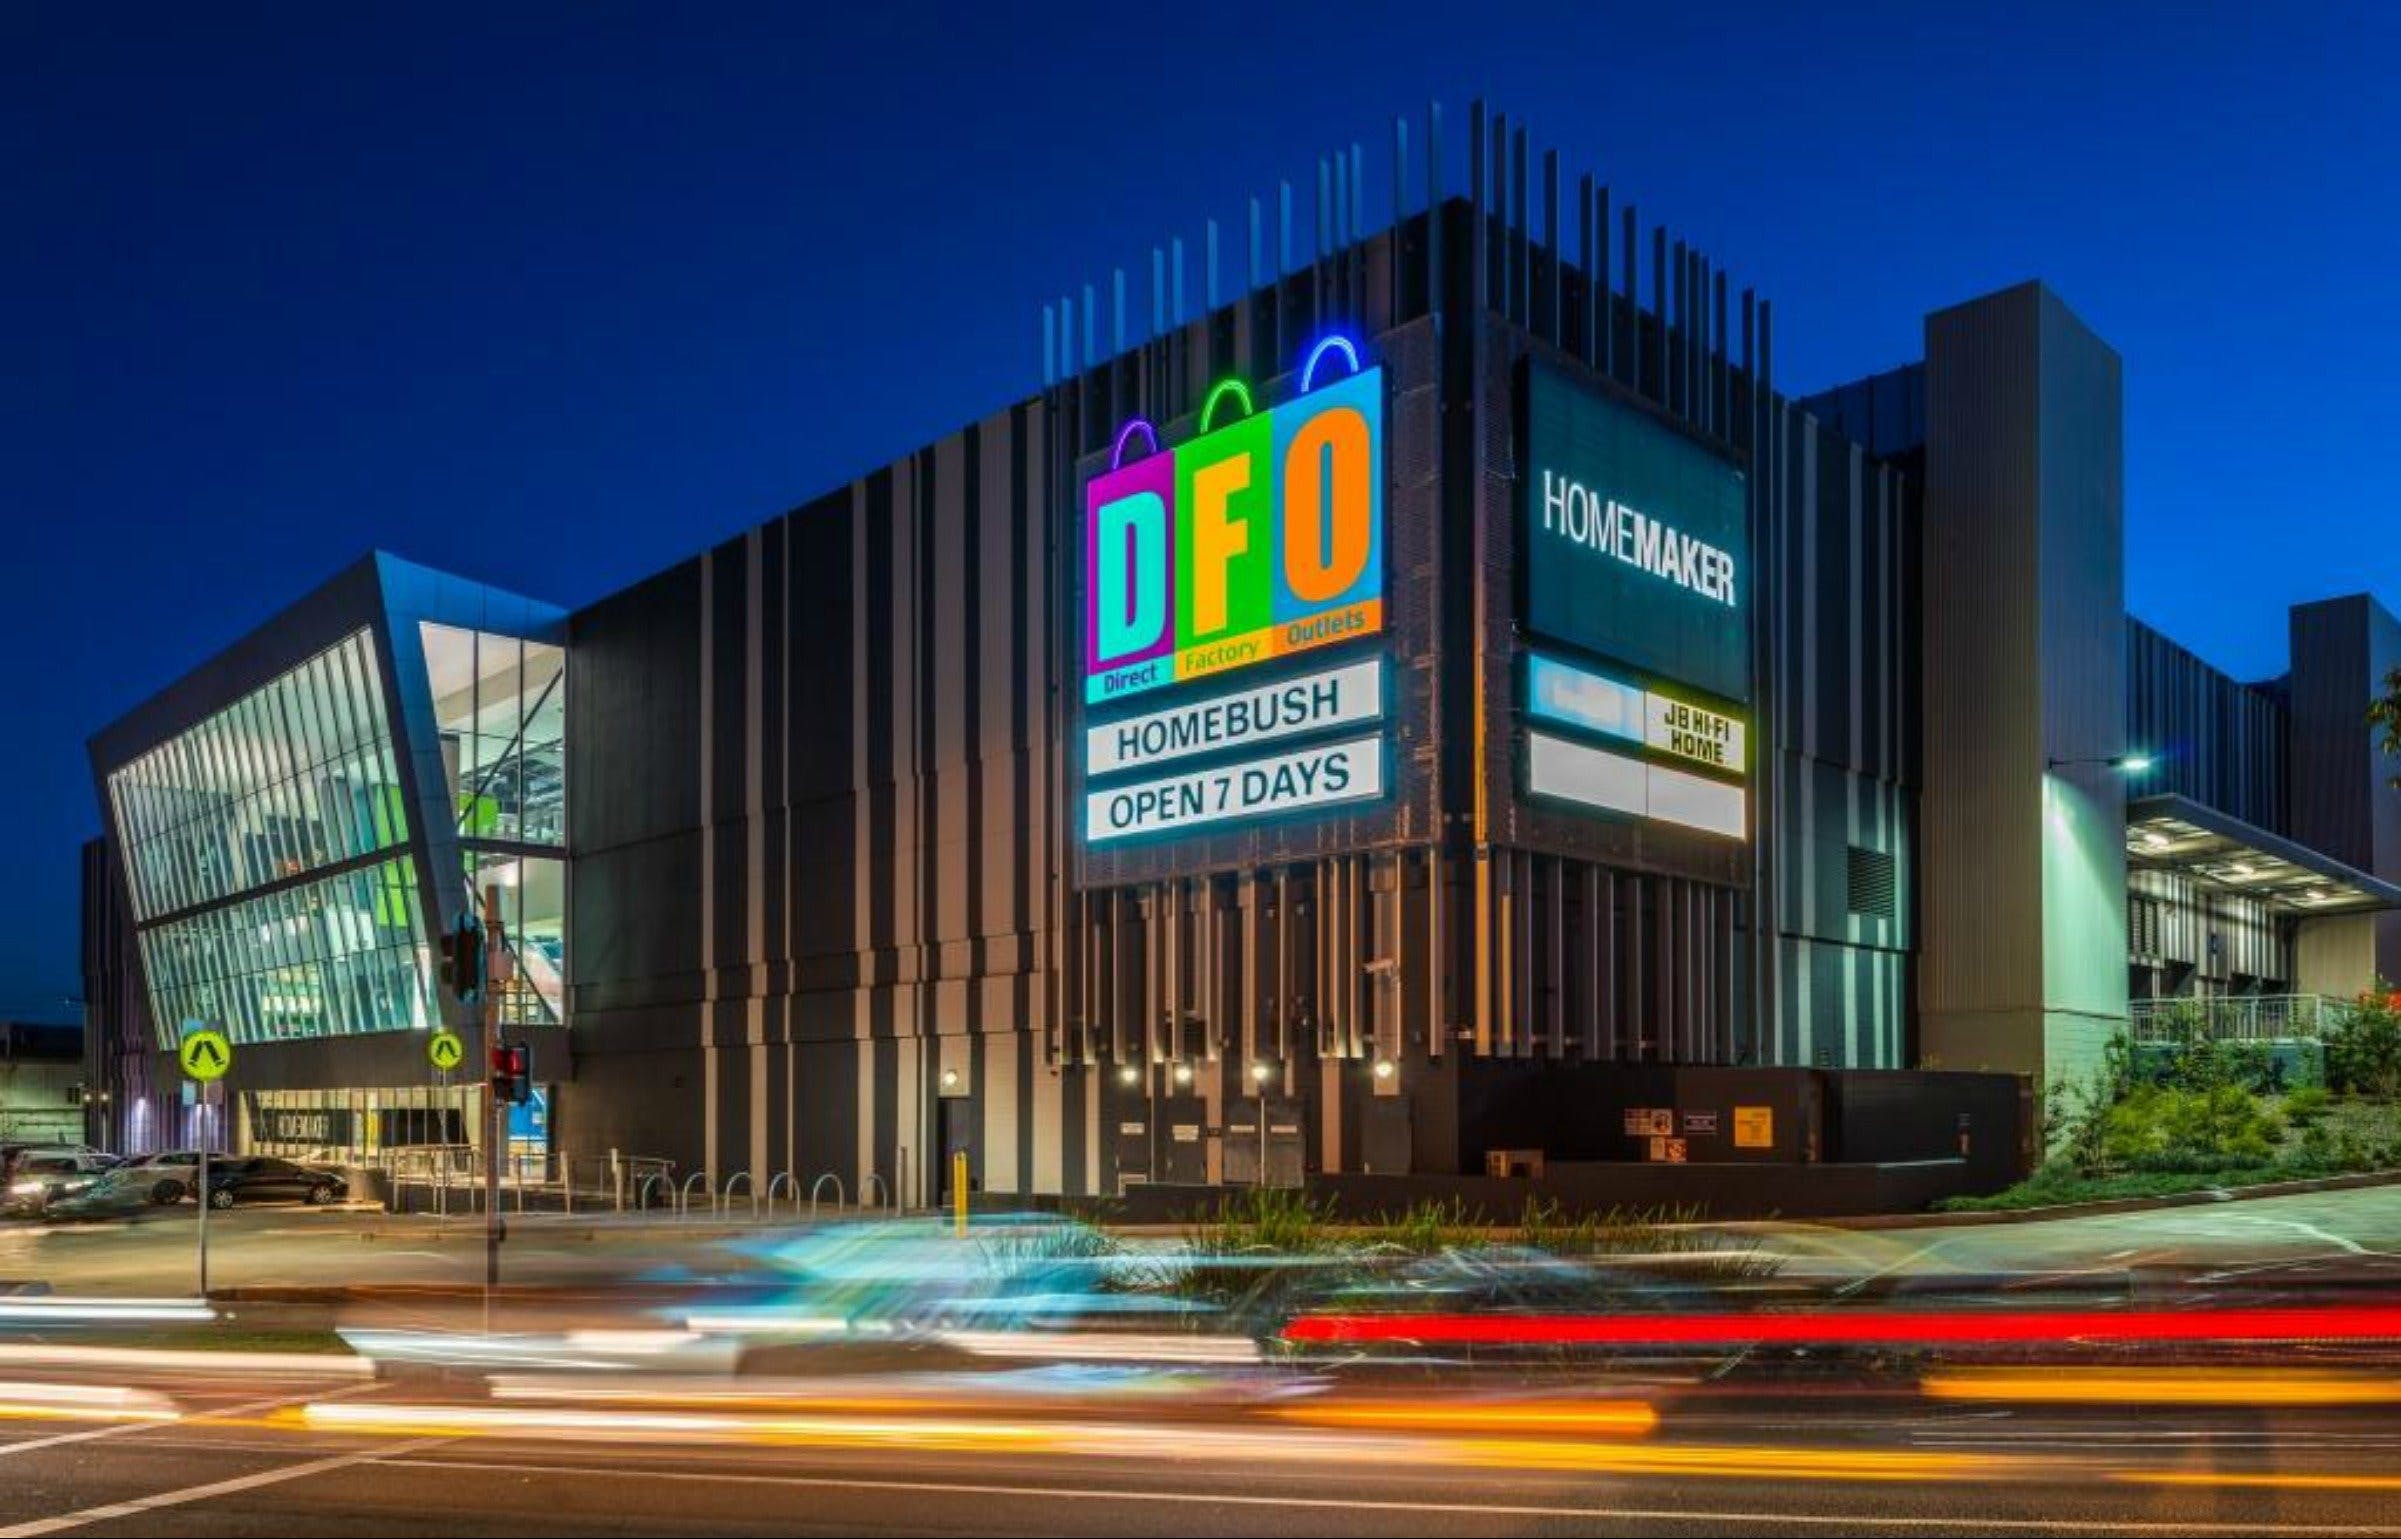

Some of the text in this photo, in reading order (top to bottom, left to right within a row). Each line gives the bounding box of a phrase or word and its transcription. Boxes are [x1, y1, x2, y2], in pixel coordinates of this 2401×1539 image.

[1099, 406, 1371, 663] DFO
[1543, 469, 1735, 607] HOMEMAKER
[1103, 609, 1366, 694] Direct Factory Outlets
[1117, 679, 1338, 759] HOMEBUSH
[1664, 703, 1689, 730] JB
[1671, 729, 1725, 765] HOME
[1110, 752, 1350, 828] OPEN 7 DAYS
